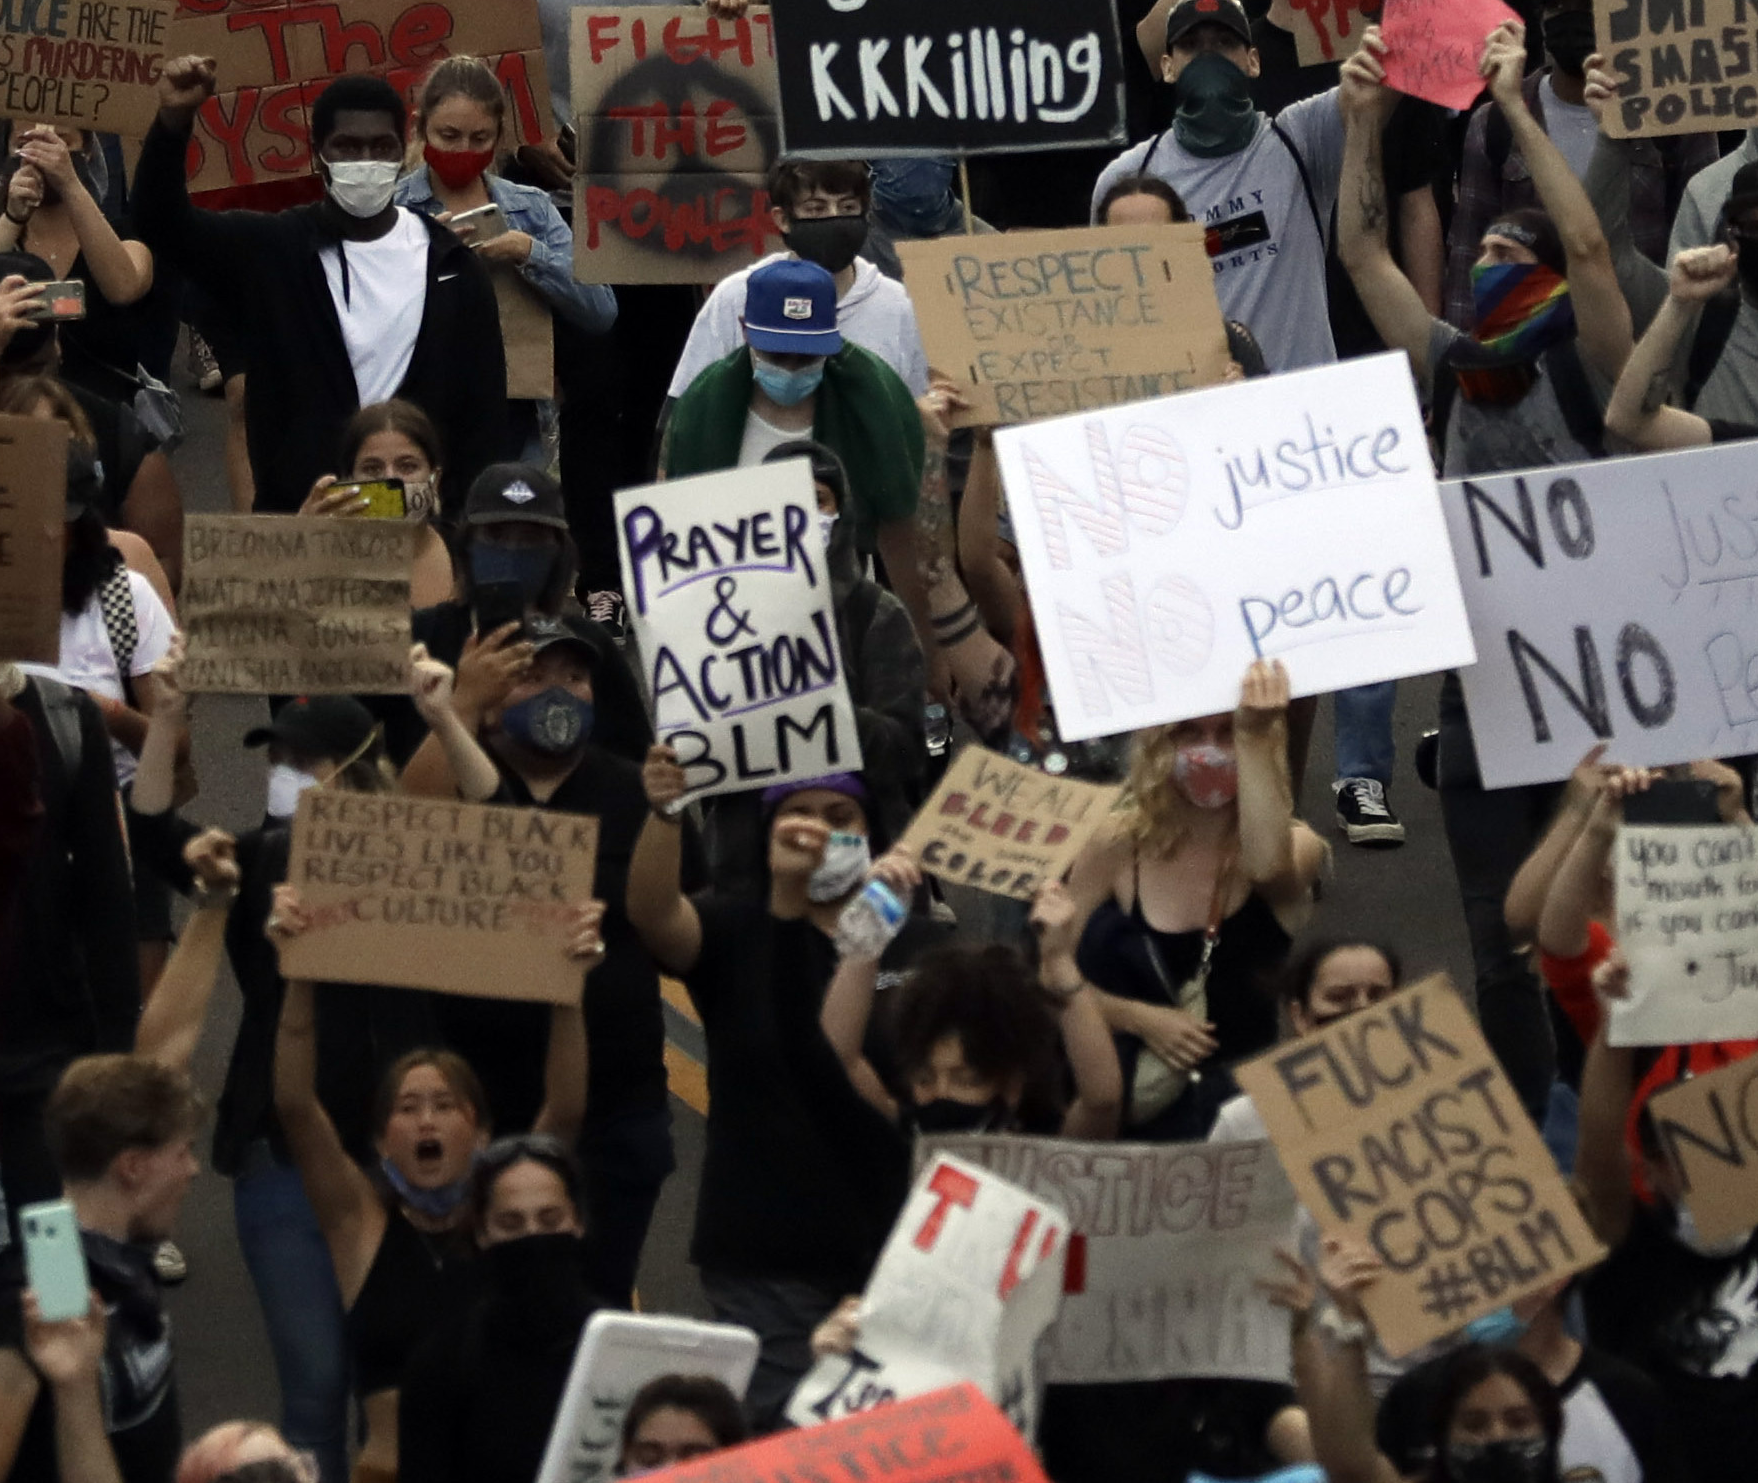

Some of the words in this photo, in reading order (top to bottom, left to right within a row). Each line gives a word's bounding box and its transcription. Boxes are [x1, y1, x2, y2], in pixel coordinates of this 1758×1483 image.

[77, 1, 120, 39] ARE
[123, 8, 165, 46] THE
[625, 100, 746, 161] THE
[954, 247, 1147, 304] RESPECT
[1213, 412, 1411, 533] justice
[1462, 475, 1597, 578] NO
[624, 503, 818, 617] PRAYER
[1240, 564, 1424, 661] peace
[652, 610, 838, 722] ACTION
[1507, 622, 1678, 745] NO
[670, 703, 841, 791] BLM
[310, 797, 464, 833] RESPECT
[483, 814, 590, 853] BLACK
[1271, 1002, 1459, 1132] FUCK
[1310, 1066, 1517, 1223] RACIST
[1368, 1143, 1534, 1274] COPS
[1416, 1209, 1575, 1322] #BLM
